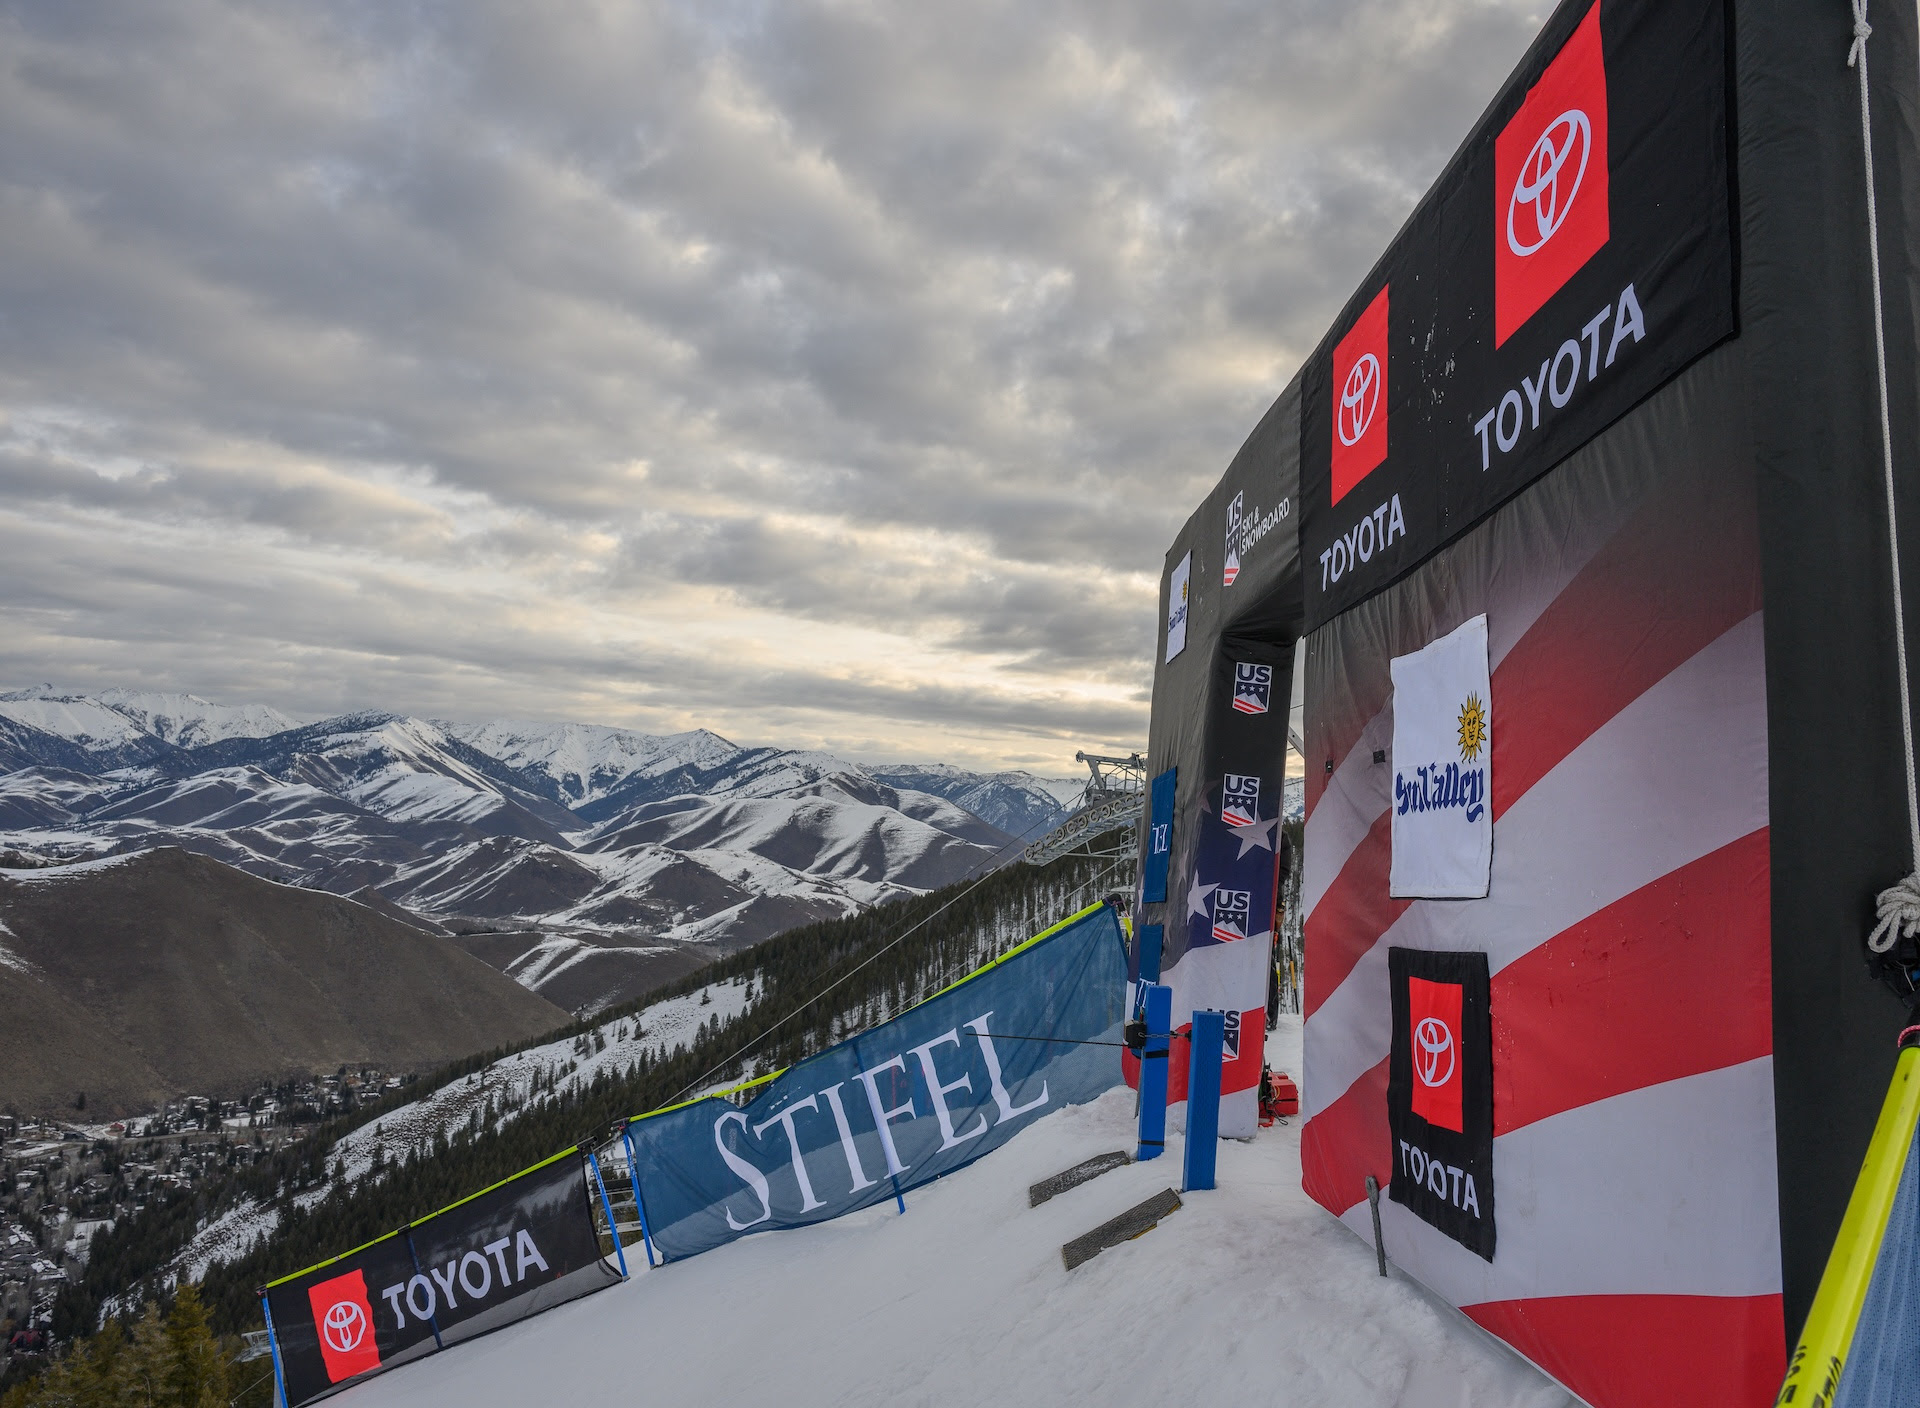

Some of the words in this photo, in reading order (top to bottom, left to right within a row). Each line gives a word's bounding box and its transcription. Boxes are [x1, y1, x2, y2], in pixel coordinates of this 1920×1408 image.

[1474, 283, 1646, 472] TOYOTA
[1227, 493, 1242, 535] US
[1241, 497, 1290, 556] SNOWBOARD
[1242, 511, 1253, 537] SKI
[1319, 493, 1406, 592] TOYOTA
[1237, 663, 1271, 683] US
[1225, 775, 1258, 795] US
[1216, 890, 1249, 911] US
[713, 1010, 1050, 1231] STIFEL
[1399, 1138, 1481, 1219] TOYOTA
[382, 1228, 550, 1330] TOYOTA
